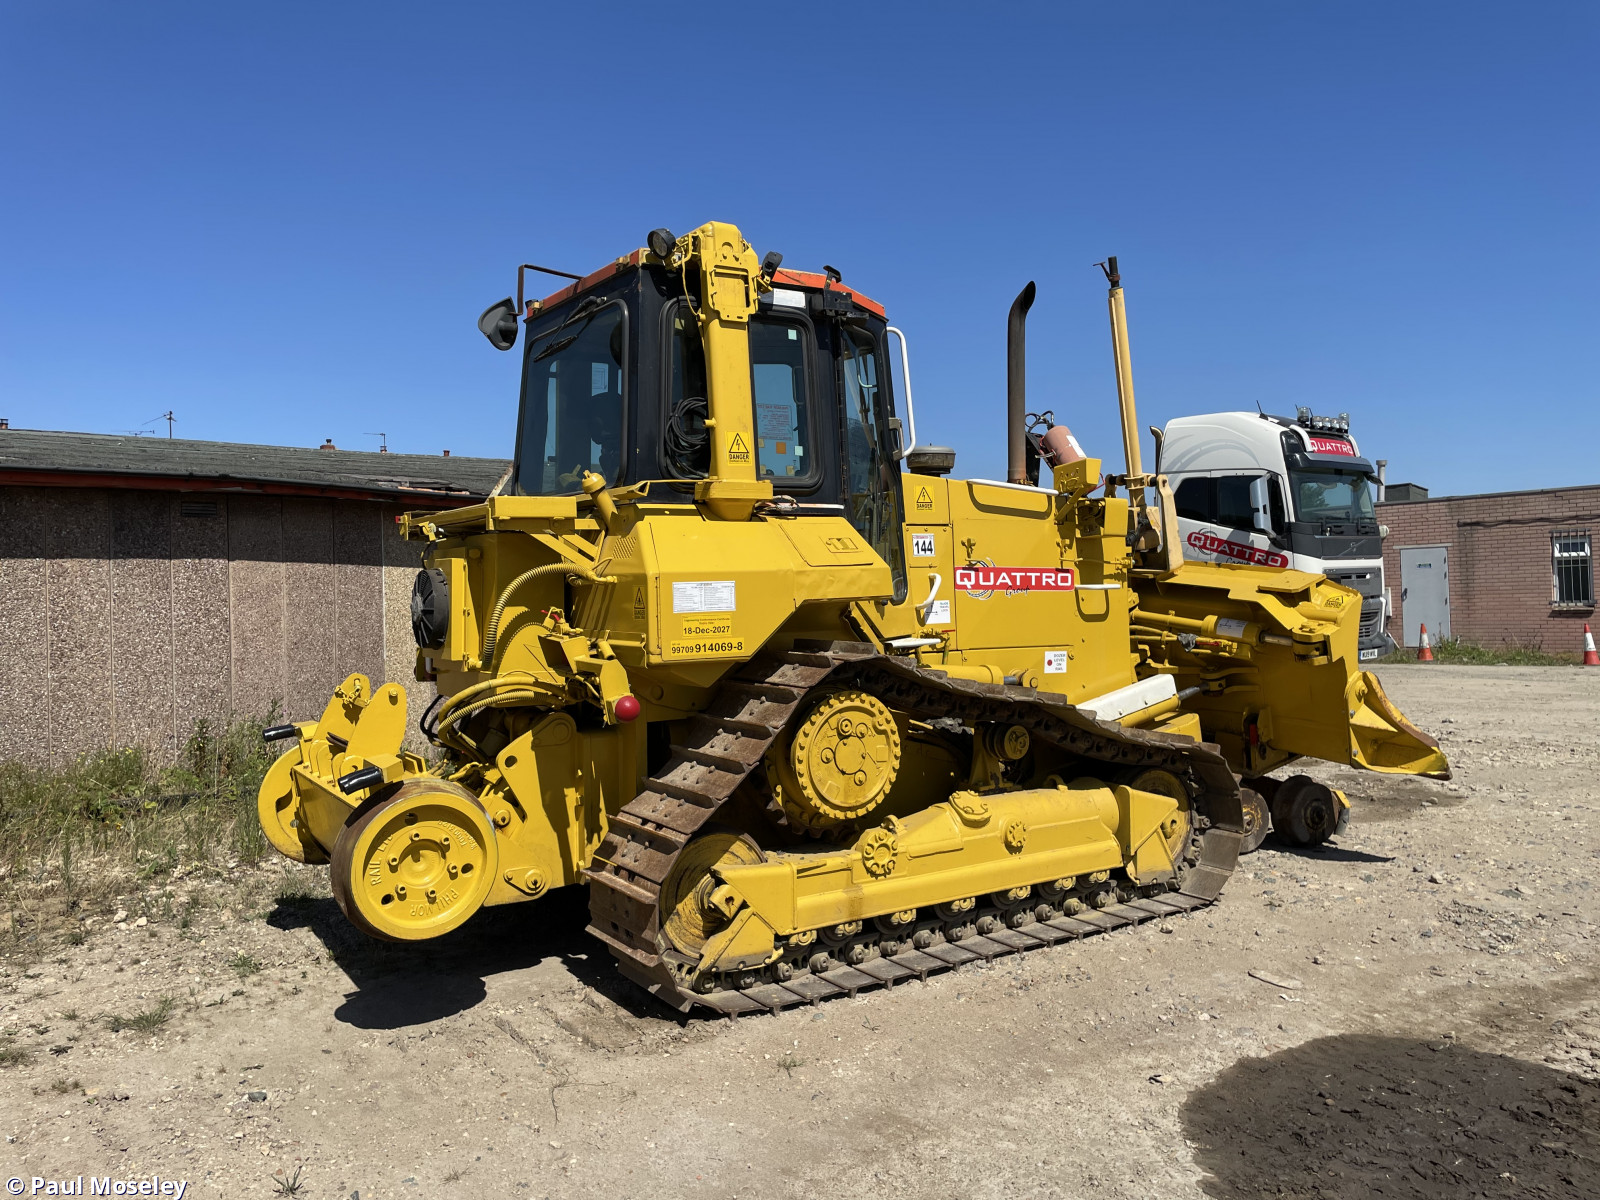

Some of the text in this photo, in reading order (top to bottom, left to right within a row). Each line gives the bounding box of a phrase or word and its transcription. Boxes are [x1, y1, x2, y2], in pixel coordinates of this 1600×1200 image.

[1310, 440, 1353, 454] QUATTRO
[915, 540, 933, 554] 144
[1190, 533, 1283, 567] QUATTRO
[955, 569, 1072, 589] QUATTRO
[1005, 585, 1031, 597] Group
[683, 626, 730, 635] 18-Dec-2027
[671, 642, 743, 654] 99709 914069-8
[369, 859, 382, 886] RAIL
